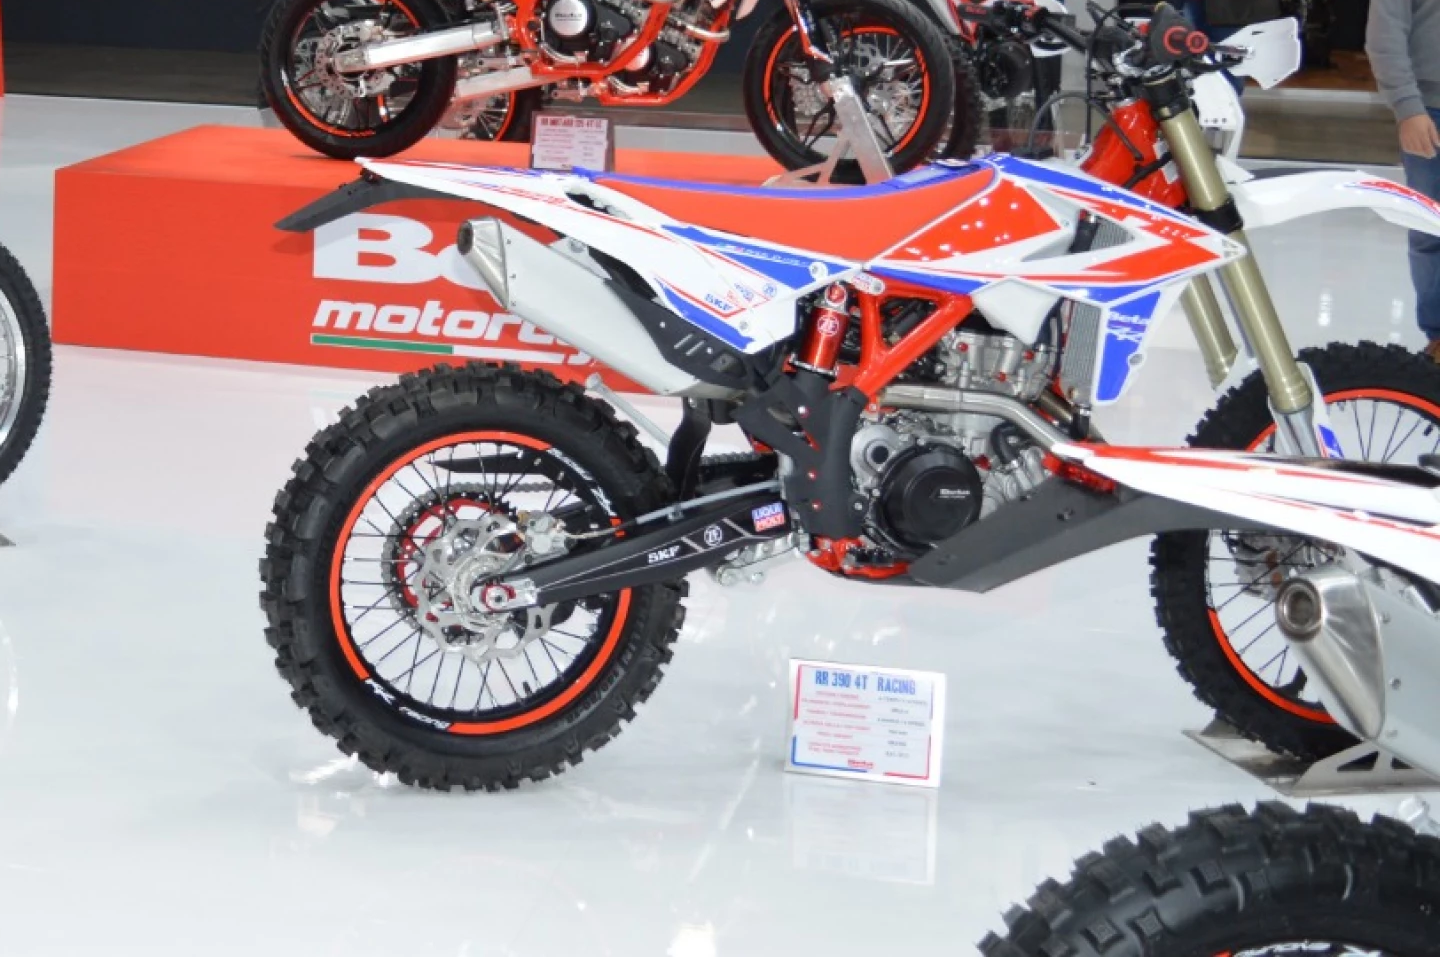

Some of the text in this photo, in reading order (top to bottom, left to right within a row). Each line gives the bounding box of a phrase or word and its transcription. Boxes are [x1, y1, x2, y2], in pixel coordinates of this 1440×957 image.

[311, 298, 598, 367] motorc
[647, 545, 681, 563] SKF
[815, 669, 829, 687] RR
[854, 675, 869, 691] 4T
[877, 676, 916, 695] RACING
